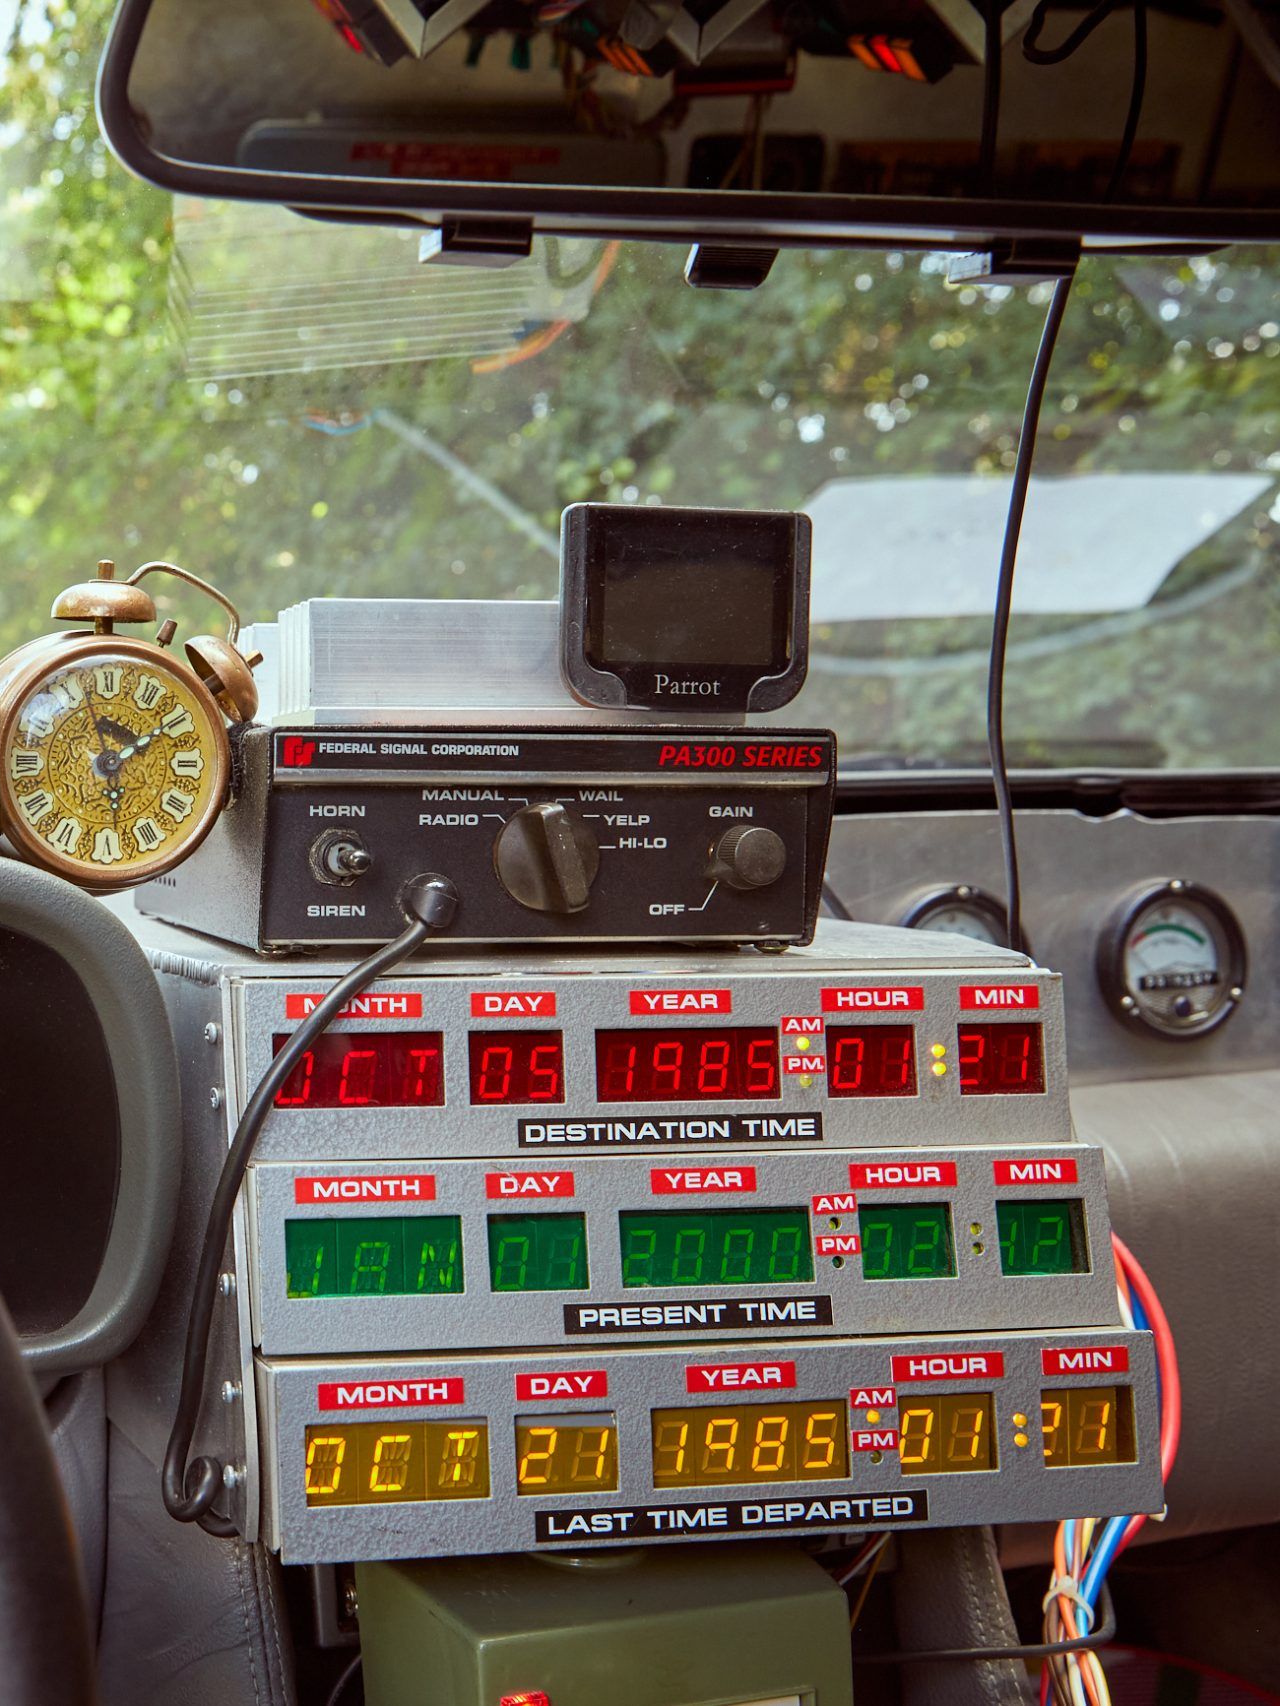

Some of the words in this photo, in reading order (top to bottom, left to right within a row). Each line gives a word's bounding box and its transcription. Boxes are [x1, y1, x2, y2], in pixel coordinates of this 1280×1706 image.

[655, 674, 721, 696] Parrot
[319, 742, 376, 754] FEDERAL
[381, 743, 428, 755] SIGNAL
[431, 744, 519, 756] CORPORATION
[658, 745, 736, 767] PA300
[742, 746, 822, 768] SERIES
[422, 790, 505, 801] MANUAL
[579, 790, 624, 802] WAIL
[309, 805, 366, 817] HORN
[709, 806, 753, 818] GAIN
[419, 814, 479, 826] RADIO
[604, 814, 650, 826] YELP
[619, 837, 667, 849] HI-LO
[307, 904, 366, 917] SIREN
[649, 904, 685, 916] OFF
[484, 996, 543, 1012] DAY
[643, 993, 718, 1010] YEAR
[837, 990, 909, 1007] HOUR
[975, 988, 1025, 1005] MIN
[304, 997, 407, 1014] MNTH
[785, 1018, 821, 1032] AM
[626, 1040, 774, 1093] 1985
[788, 1057, 822, 1070] PM
[833, 1038, 910, 1089] 01
[479, 1046, 559, 1099] 05
[525, 1120, 730, 1142] DESTINATION
[742, 1118, 815, 1137] TIME
[665, 1171, 742, 1189] YEAR
[866, 1166, 941, 1183] HOUR
[1010, 1163, 1062, 1180] MIN
[313, 1179, 420, 1198] MONTH
[500, 1176, 560, 1194] DAY
[817, 1196, 854, 1211] AM
[821, 1237, 856, 1251] PM
[624, 1227, 802, 1283] 2000
[579, 1304, 727, 1328] PRESENT
[739, 1301, 816, 1321] TIME
[909, 1356, 987, 1376] HOUR
[1059, 1351, 1113, 1369] MIN
[701, 1366, 782, 1386] YEAR
[337, 1383, 448, 1405] MONTH
[530, 1376, 593, 1395] DAY
[855, 1390, 893, 1405] AM
[675, 1413, 837, 1474] 1985
[858, 1432, 894, 1447] PM
[899, 1408, 984, 1464] 01
[306, 1431, 480, 1494] OCT
[519, 1428, 609, 1484] 21
[548, 1512, 634, 1536] LAST
[647, 1507, 728, 1530] TIME
[742, 1497, 914, 1525] DEPARTED
